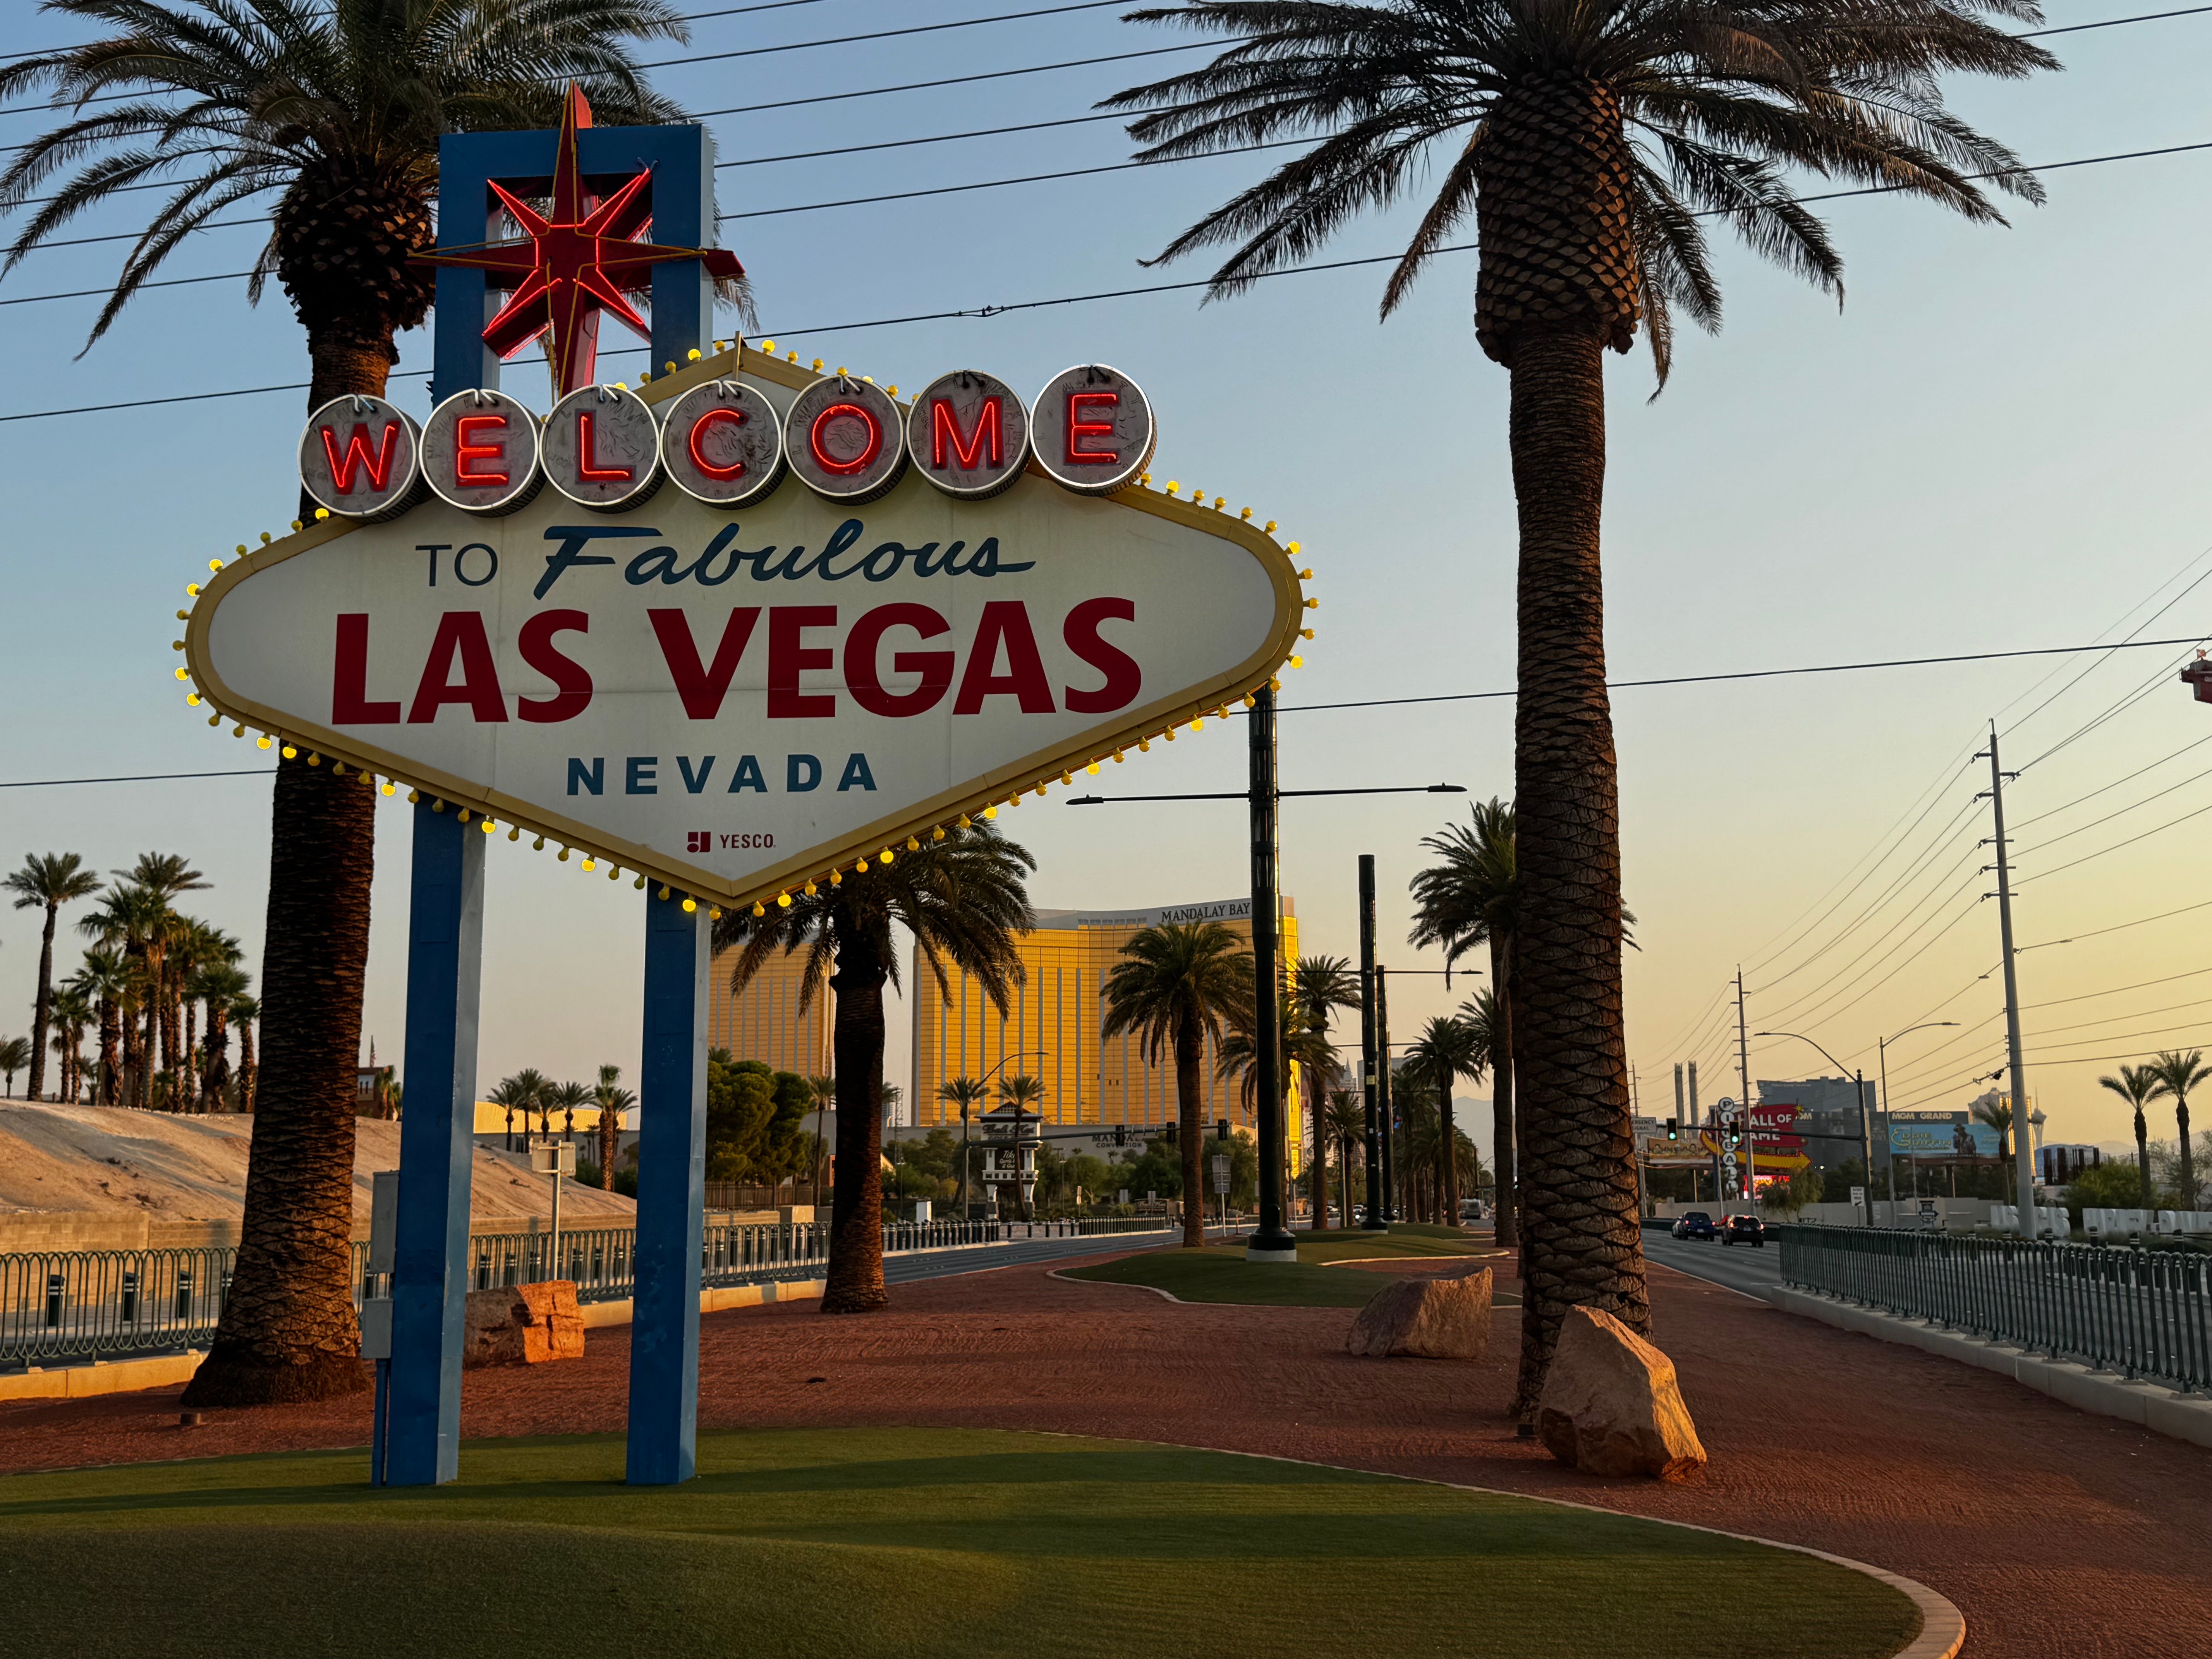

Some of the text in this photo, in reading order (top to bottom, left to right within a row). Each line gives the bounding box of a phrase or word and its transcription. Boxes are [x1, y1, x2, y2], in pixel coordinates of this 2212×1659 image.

[318, 391, 1120, 496] WELCOME
[415, 519, 1036, 600] TO Fabulous
[332, 597, 1142, 724] LAS VEGAS
[567, 753, 878, 796] NEVADA
[720, 834, 774, 849] YESCO
[1162, 902, 1251, 922] MANDALAY BAY
[1777, 1114, 1792, 1123] OF
[1740, 1128, 1781, 1141] AME
